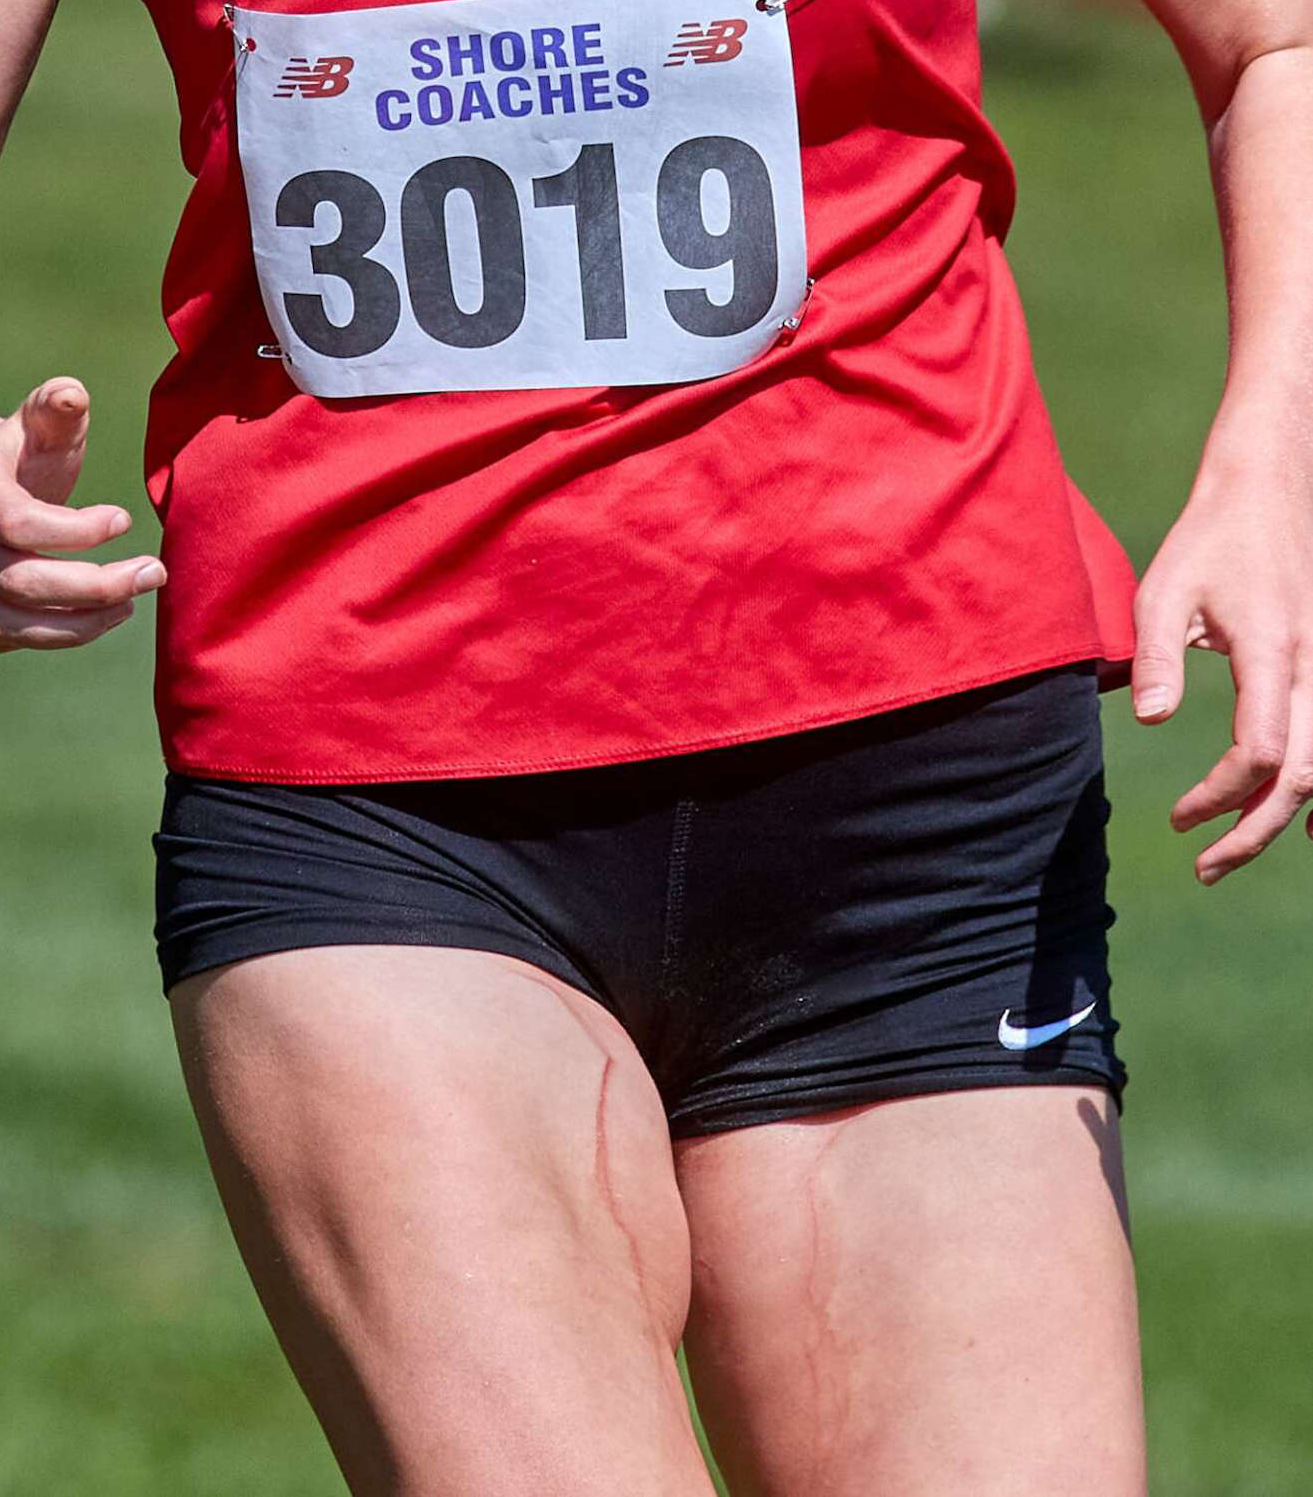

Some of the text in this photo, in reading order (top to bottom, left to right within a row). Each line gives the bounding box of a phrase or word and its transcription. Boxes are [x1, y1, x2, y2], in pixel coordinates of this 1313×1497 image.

[410, 23, 605, 82] SHORE
[376, 66, 650, 131] COACHES
[274, 135, 780, 359] 3019
